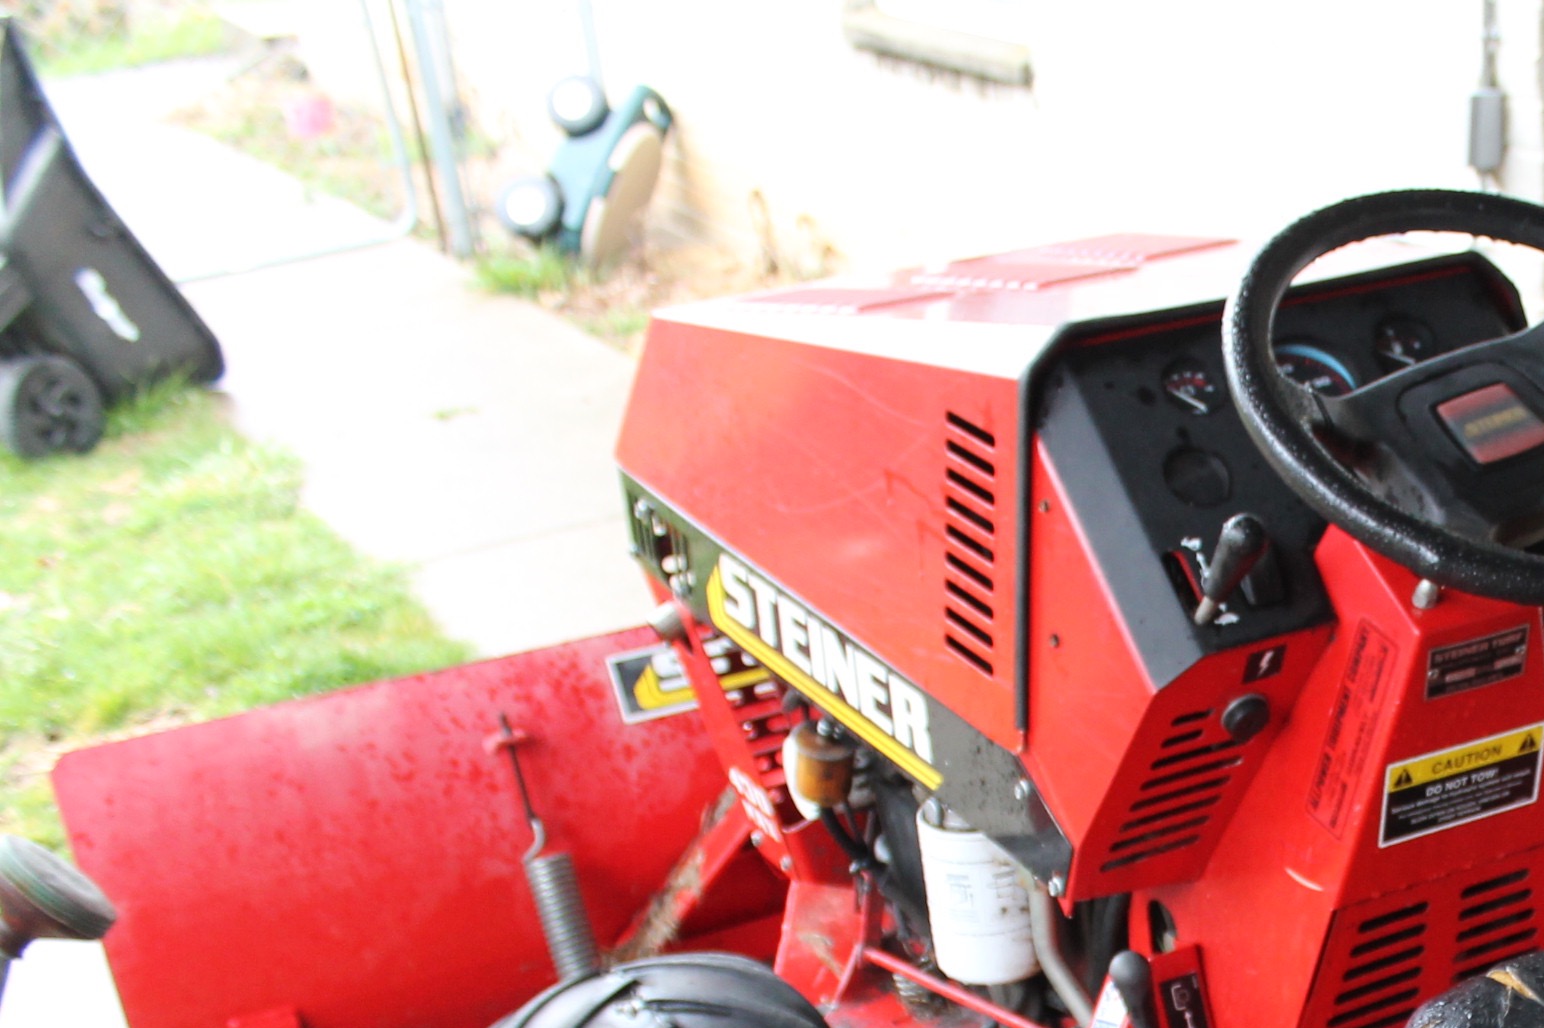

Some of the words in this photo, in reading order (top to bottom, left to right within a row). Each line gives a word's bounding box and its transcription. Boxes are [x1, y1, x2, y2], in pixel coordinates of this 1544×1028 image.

[719, 553, 935, 765] STEINER
[1434, 641, 1489, 664] STEINER
[1432, 744, 1502, 775] CAUTION
[1425, 784, 1443, 797] DO
[1445, 775, 1470, 791] NOT
